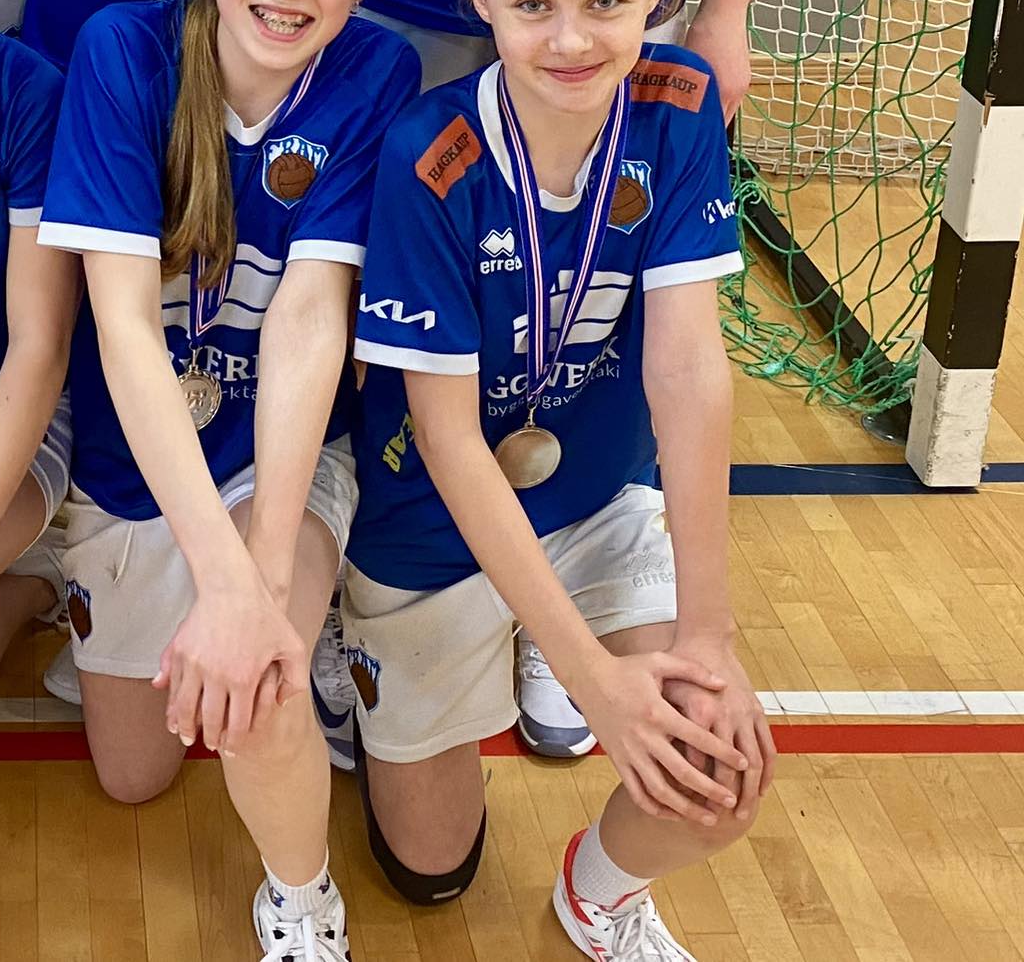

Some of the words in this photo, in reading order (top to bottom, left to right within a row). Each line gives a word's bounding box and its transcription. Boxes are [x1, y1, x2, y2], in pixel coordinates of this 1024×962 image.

[631, 71, 698, 95] HAGKAUP
[427, 132, 469, 183] HAGKAUP
[479, 255, 523, 275] errea
